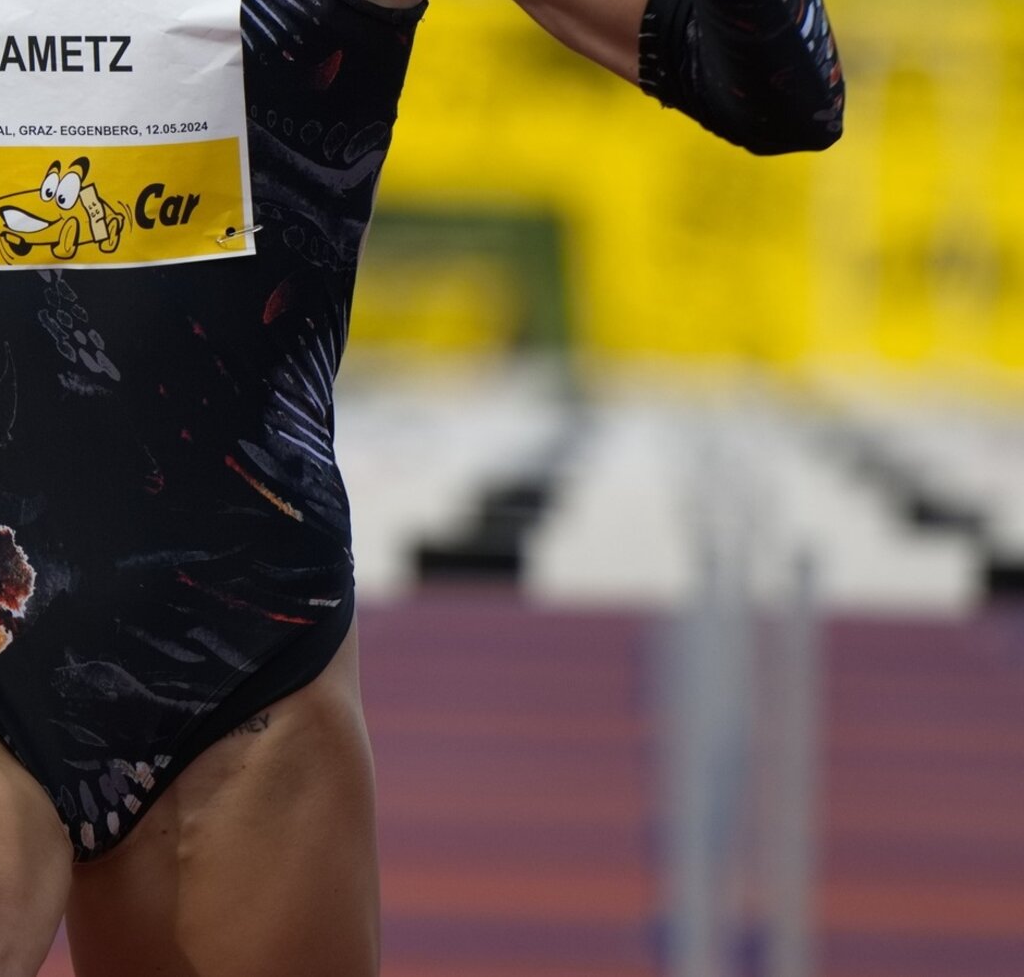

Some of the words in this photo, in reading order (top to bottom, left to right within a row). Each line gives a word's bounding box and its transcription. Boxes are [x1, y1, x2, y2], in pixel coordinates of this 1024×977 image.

[19, 125, 57, 136] GRAZ-
[60, 125, 143, 137] EGGENBERG,
[145, 121, 208, 135] 12.05.2024
[134, 183, 201, 230] Car
